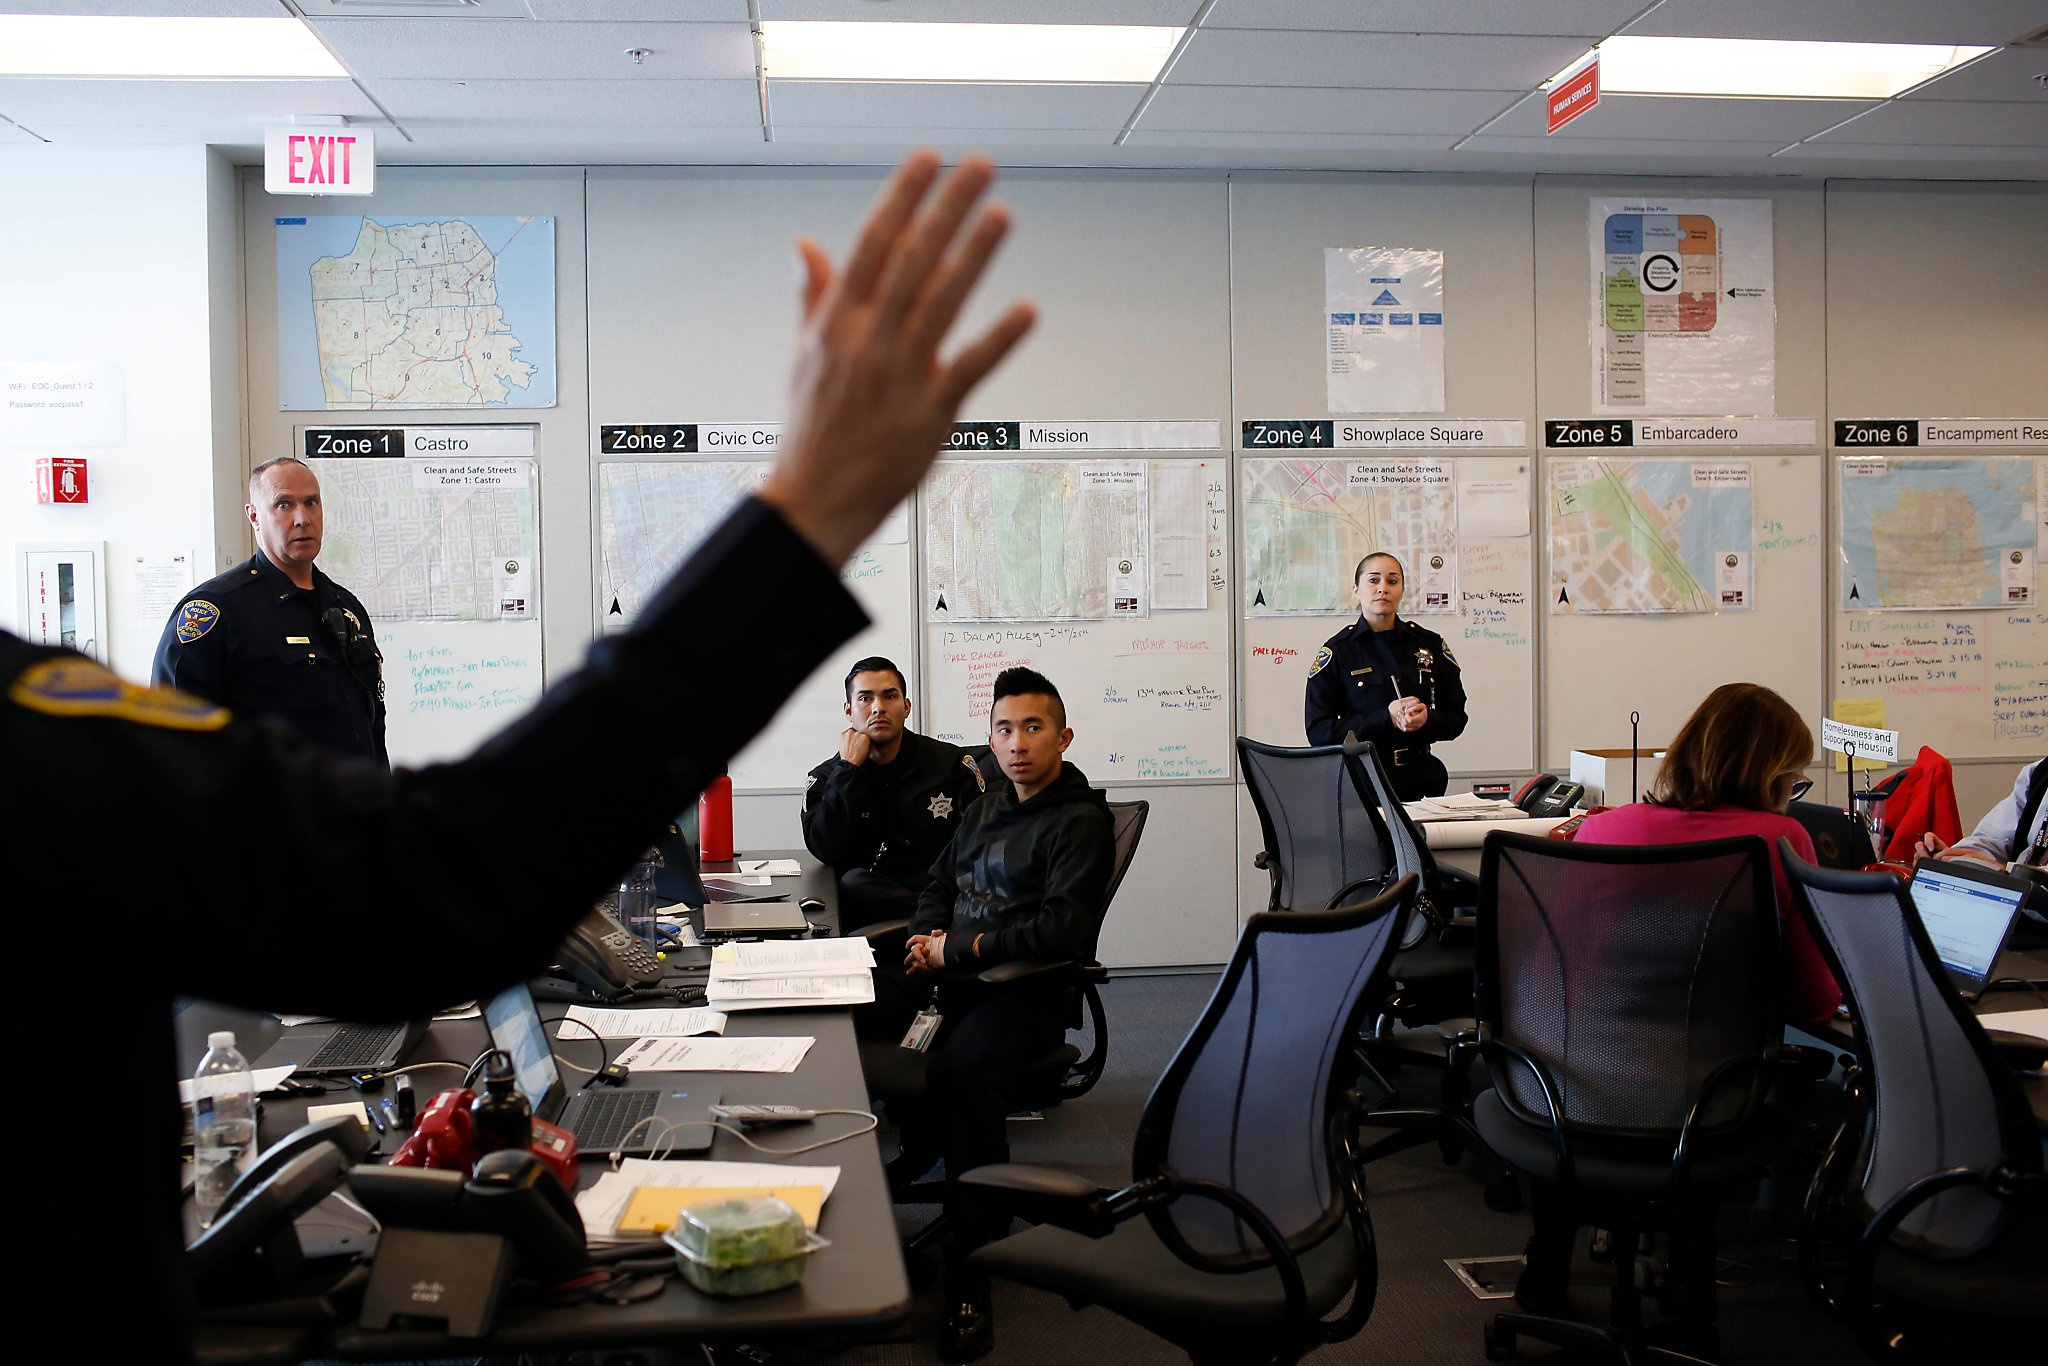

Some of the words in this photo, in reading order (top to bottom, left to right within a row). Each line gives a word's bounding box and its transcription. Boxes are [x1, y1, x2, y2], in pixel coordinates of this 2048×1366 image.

[1554, 96, 1572, 115] HUMAN
[1572, 82, 1591, 103] SERVICES
[288, 136, 356, 185] EXIT
[31, 383, 76, 391] EOC_Guest
[88, 382, 94, 390] 2
[49, 401, 83, 409] eocpass1
[612, 430, 666, 449] Zone
[673, 430, 686, 449] 2
[707, 431, 747, 446] Civic
[941, 429, 989, 446] one
[995, 427, 1008, 446] 3
[1029, 429, 1089, 443] Mission
[1253, 426, 1304, 444] Zone
[1309, 426, 1322, 443] 4
[1343, 428, 1425, 443] Showplace
[1430, 428, 1484, 443] Square
[1556, 425, 1605, 443] Zone
[1610, 425, 1622, 442] 5
[1641, 426, 1738, 440] Embarcadero
[1845, 425, 1891, 443] Zone
[1897, 425, 1908, 443] 6
[1927, 427, 2018, 443] Encampment
[317, 435, 372, 454] Zone
[380, 435, 390, 454] 1
[414, 436, 469, 451] Castro
[424, 466, 447, 474] Clean
[449, 466, 465, 474] and
[467, 466, 485, 474] Safe
[487, 466, 517, 474] Streets
[1357, 466, 1379, 474] Clean
[1380, 466, 1395, 474] and
[1397, 466, 1413, 474] Safe
[1415, 466, 1442, 474] Streets
[474, 476, 501, 484] Castro
[1381, 475, 1421, 484] Showplace
[1423, 476, 1450, 484] Square
[1209, 549, 1222, 558] 63
[1825, 721, 1873, 740] Homelessness
[1874, 732, 1892, 743] and
[1824, 731, 1857, 748] Supportive
[1858, 740, 1894, 757] Housing
